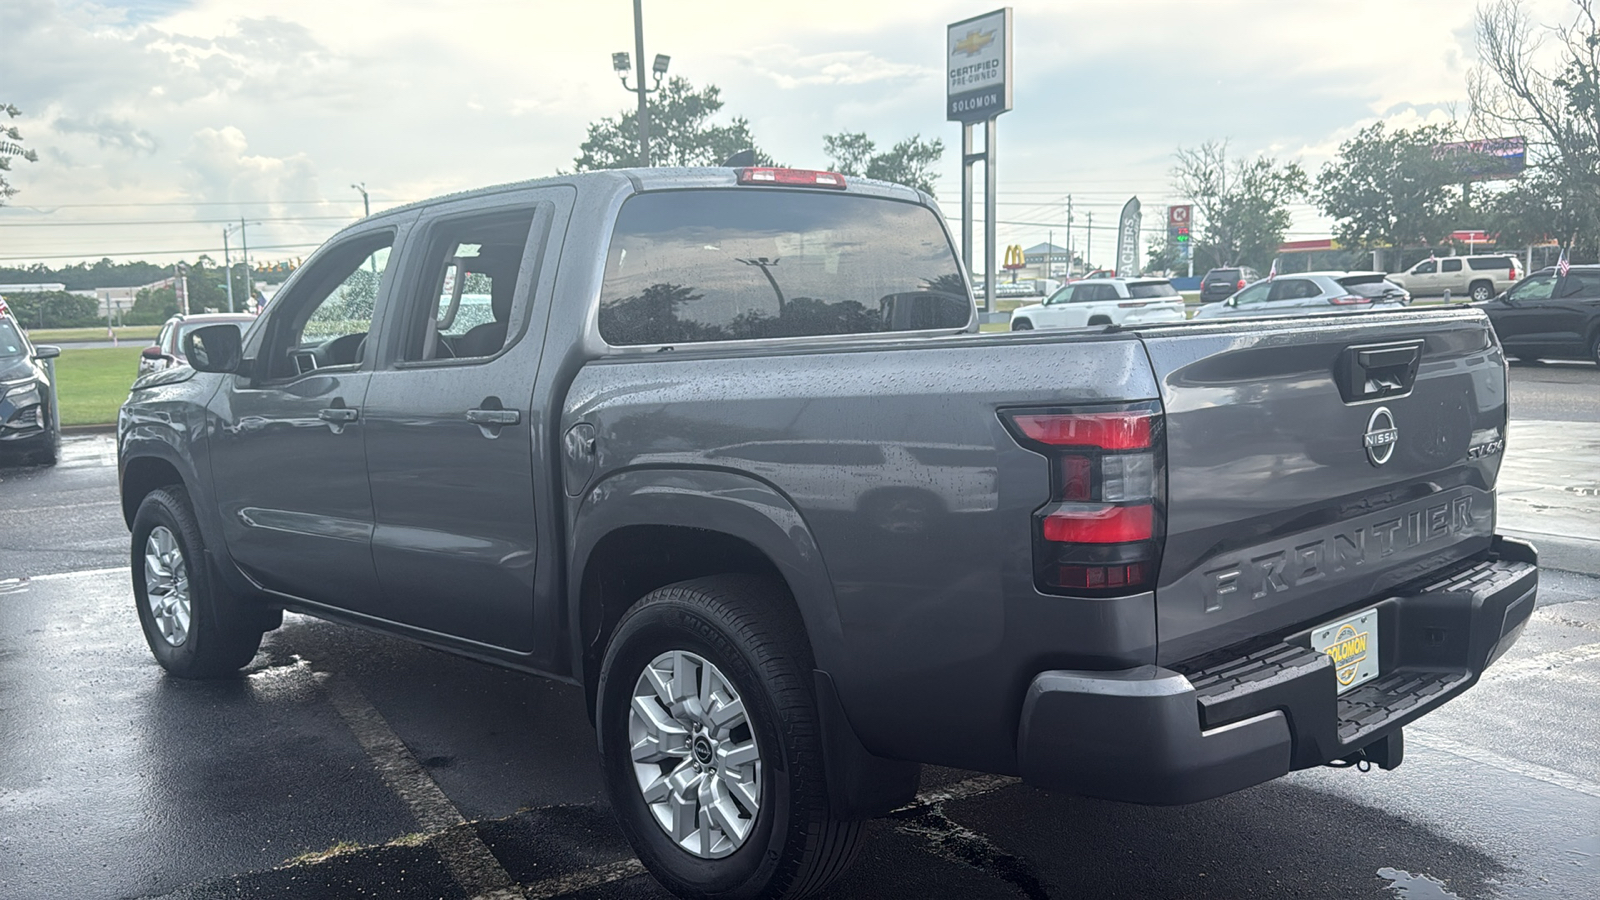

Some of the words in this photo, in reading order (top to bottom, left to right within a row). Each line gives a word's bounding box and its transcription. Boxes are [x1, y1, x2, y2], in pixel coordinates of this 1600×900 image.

[950, 59, 1000, 79] CERTIFIED
[952, 69, 998, 87] PRE-OWNED
[952, 94, 997, 113] SOLOMON
[1365, 431, 1398, 447] NISSAN
[1202, 493, 1475, 614] FRONTIER
